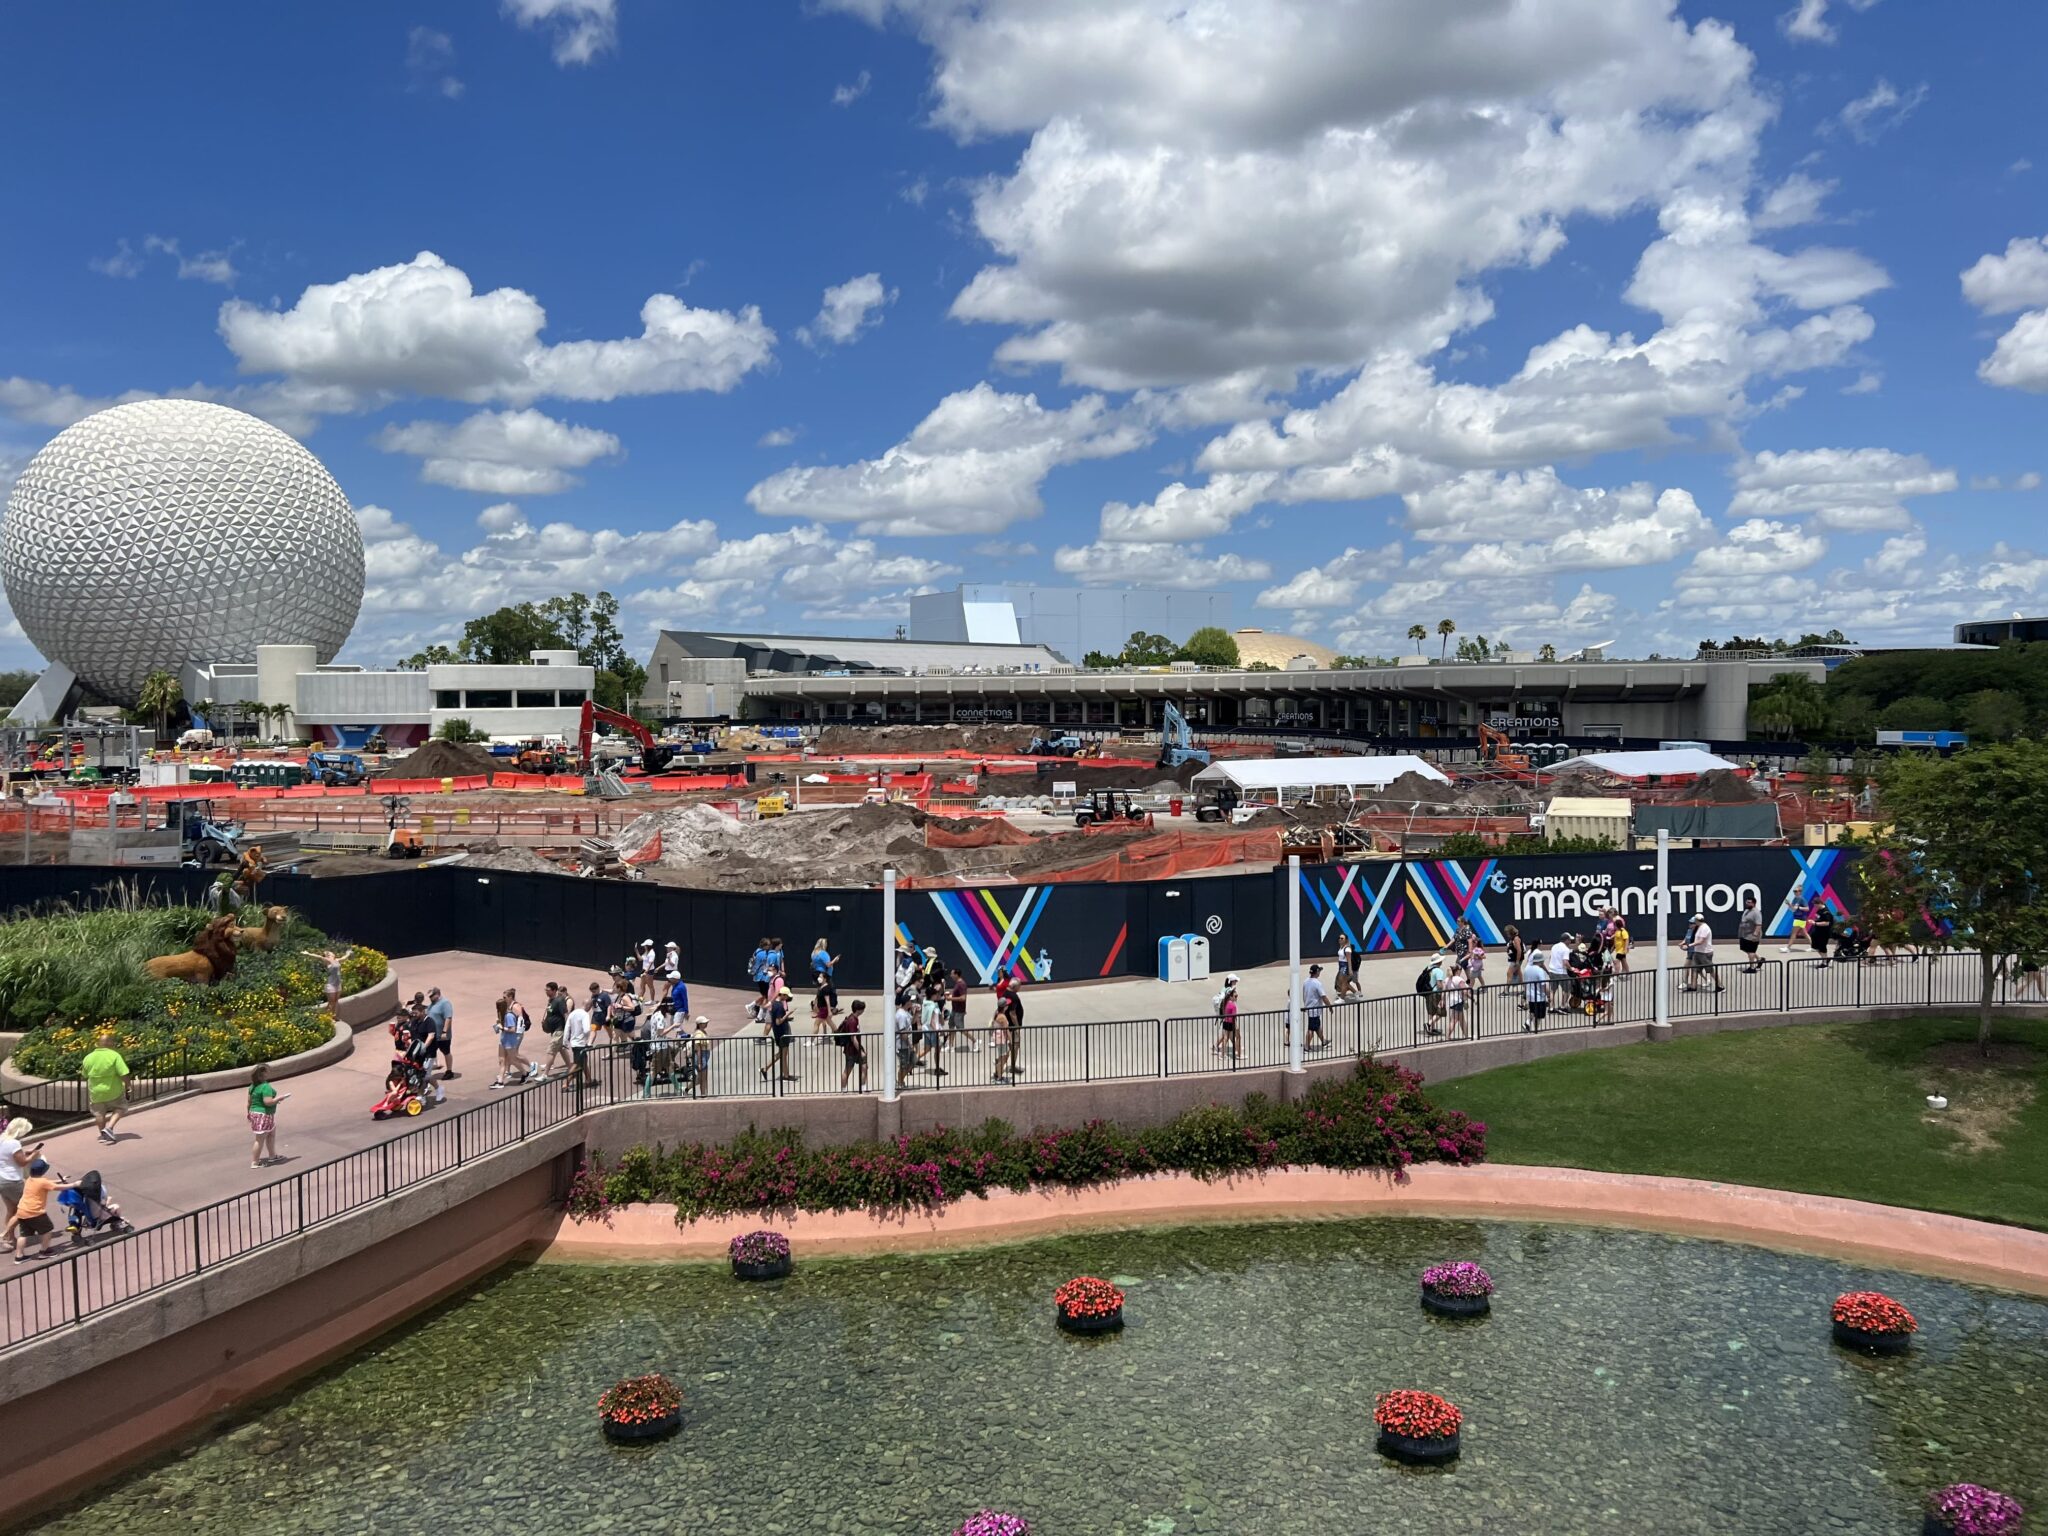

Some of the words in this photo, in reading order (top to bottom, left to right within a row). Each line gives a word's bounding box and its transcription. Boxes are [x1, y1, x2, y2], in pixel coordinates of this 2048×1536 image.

[956, 709, 1013, 717] CONNECTIONS
[1277, 712, 1314, 720] CREATIONS
[1490, 717, 1560, 727] CREATIONS
[1513, 876, 1564, 890] SPARK
[1567, 874, 1612, 888] YOUR
[1513, 882, 1762, 920] IMAGINATION
